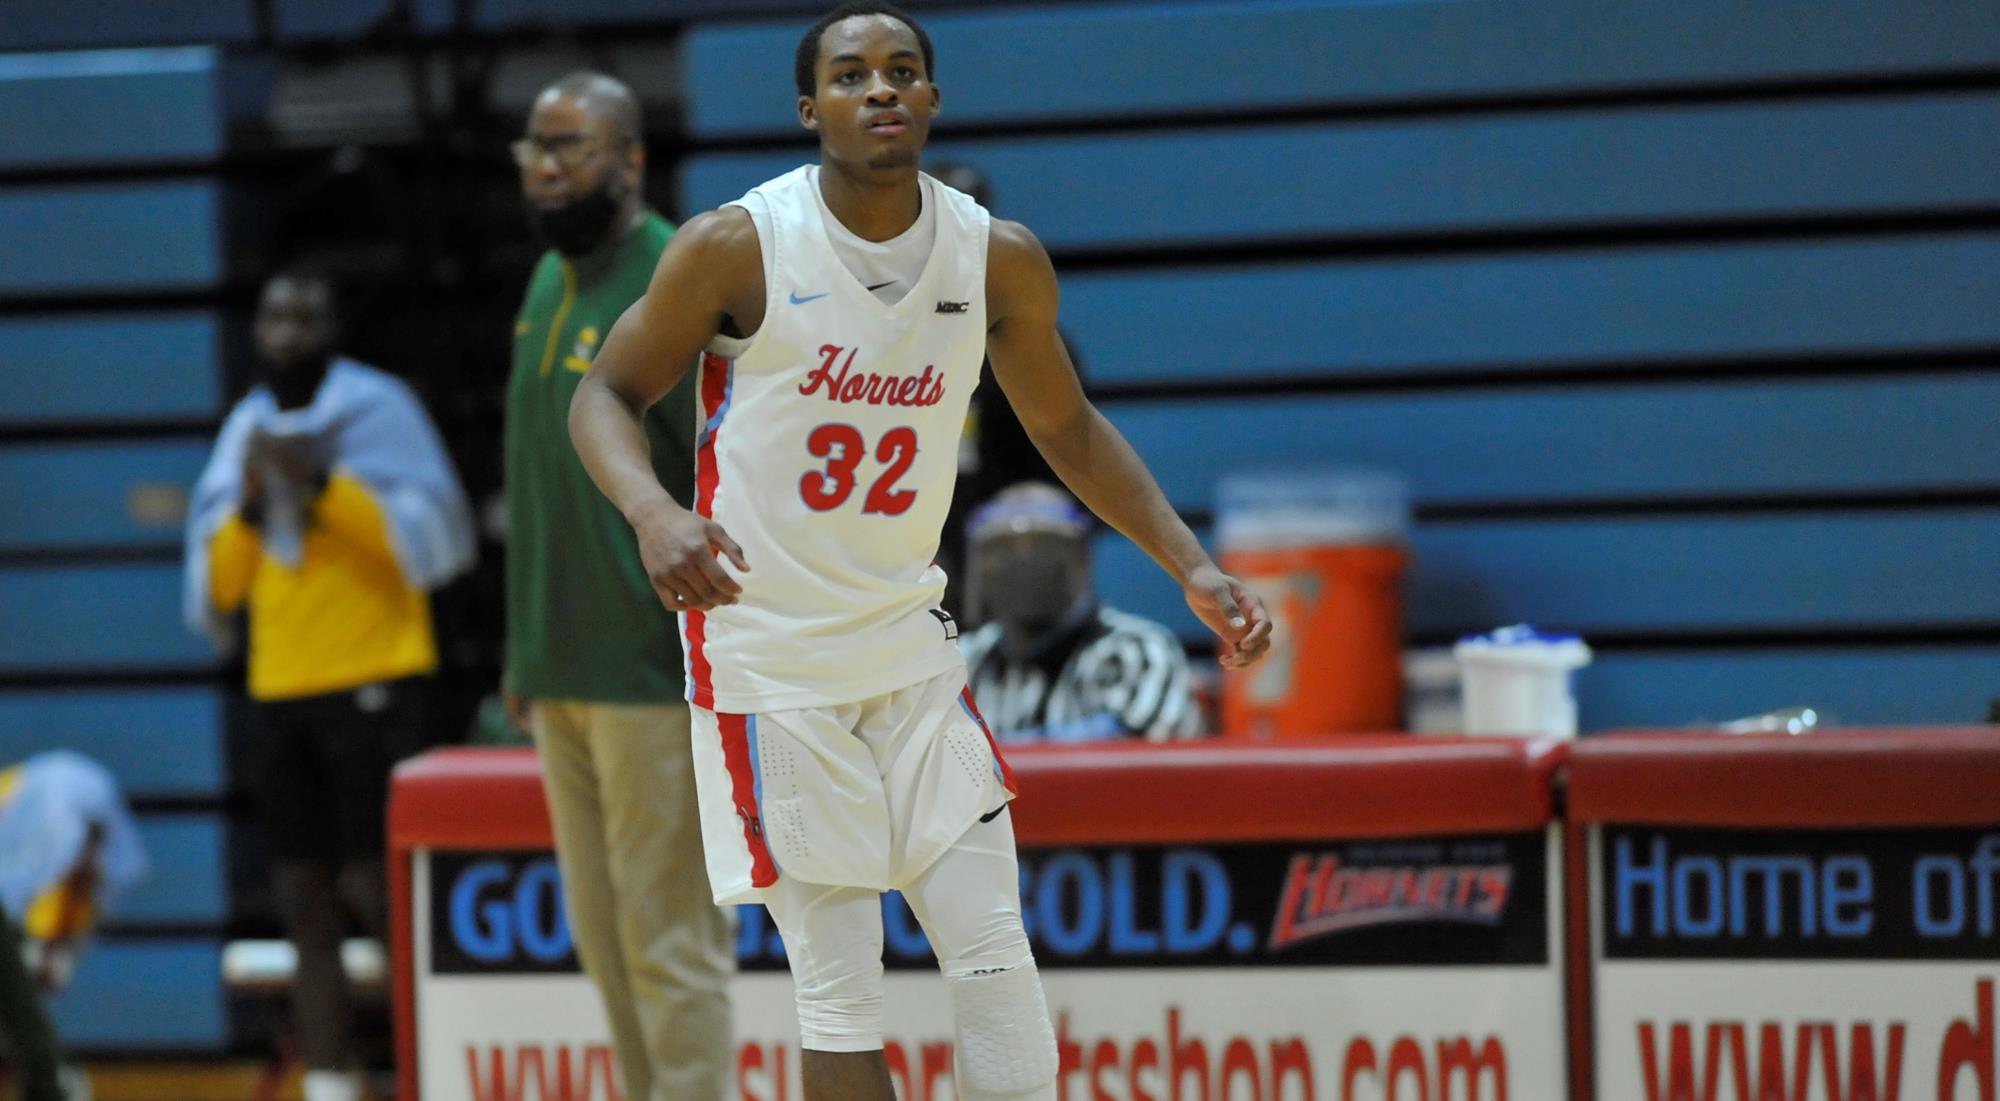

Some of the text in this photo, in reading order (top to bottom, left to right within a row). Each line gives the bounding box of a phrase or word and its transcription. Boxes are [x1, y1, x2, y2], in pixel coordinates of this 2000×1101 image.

[798, 344, 945, 407] Hornets
[799, 422, 919, 517] 32
[1018, 849, 1256, 955] OLD.
[1614, 836, 1874, 938] Home
